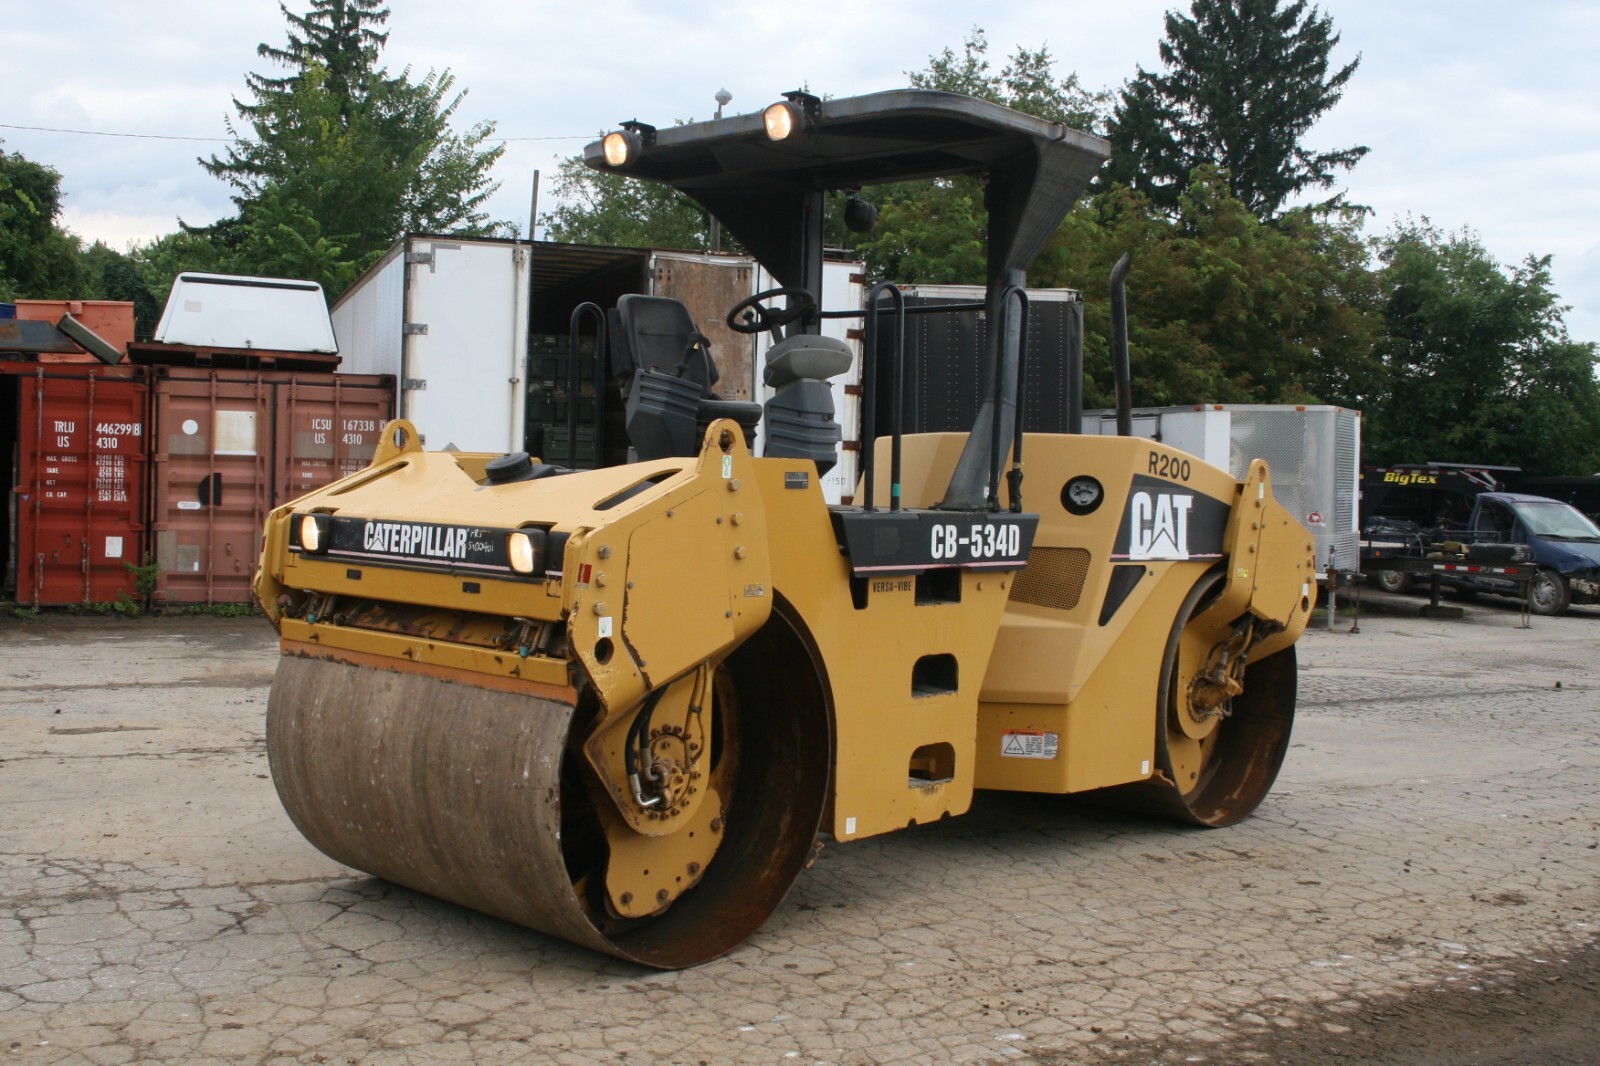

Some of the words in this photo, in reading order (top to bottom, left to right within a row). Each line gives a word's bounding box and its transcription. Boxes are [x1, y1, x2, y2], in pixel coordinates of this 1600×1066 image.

[54, 421, 75, 433] TRLU
[312, 419, 332, 430] ICSU
[343, 420, 374, 431] 167338
[57, 436, 70, 448] US
[96, 437, 118, 449] 4310
[315, 433, 326, 444] US
[342, 434, 362, 445] 4310
[1148, 450, 1191, 482] R200
[1129, 491, 1193, 560] CAT
[364, 521, 467, 559] CATERPILLAR
[931, 524, 1020, 559] CB-534D
[872, 581, 912, 593] VERSA-VIBE
